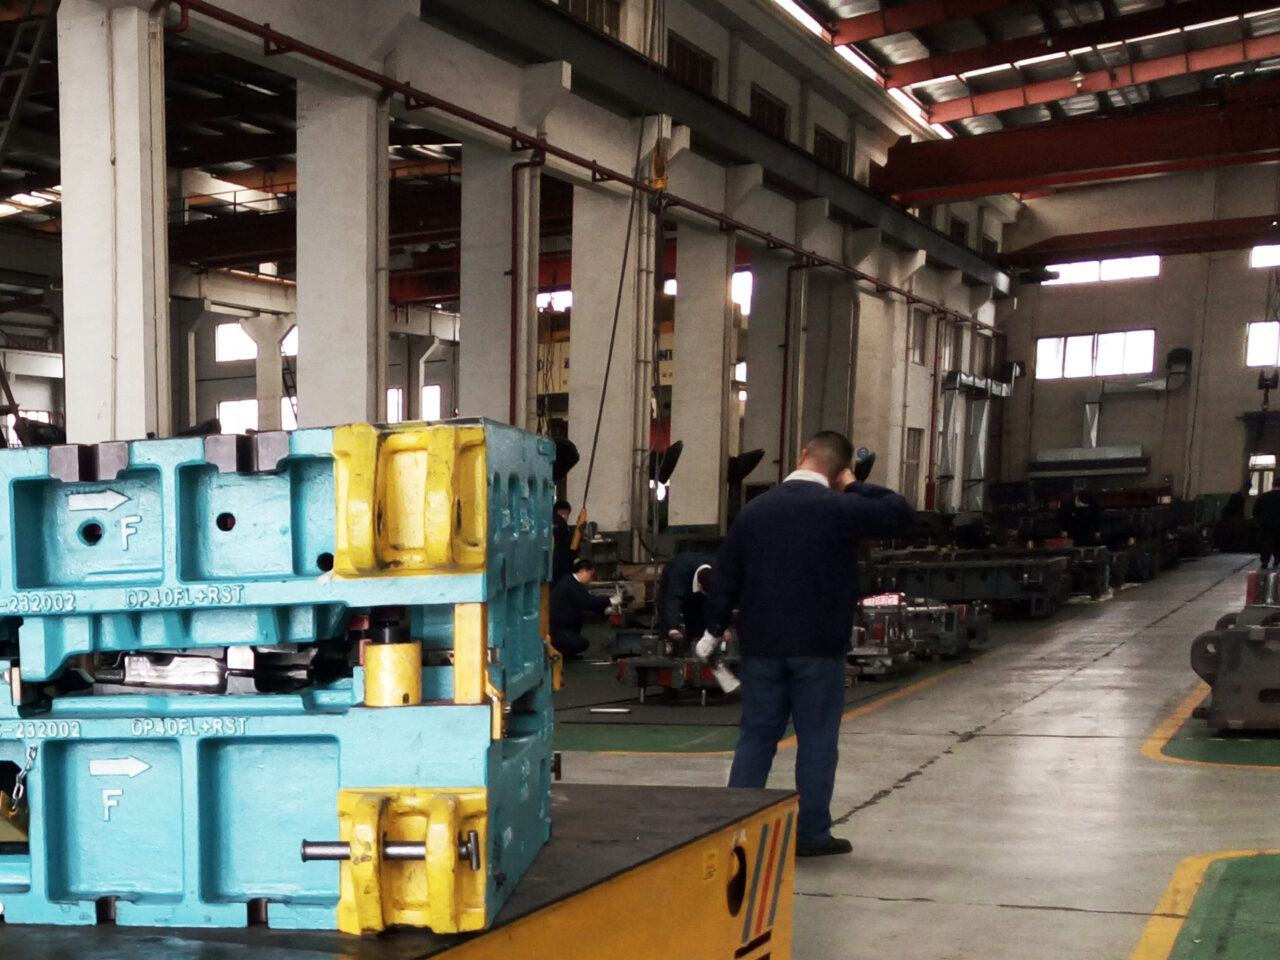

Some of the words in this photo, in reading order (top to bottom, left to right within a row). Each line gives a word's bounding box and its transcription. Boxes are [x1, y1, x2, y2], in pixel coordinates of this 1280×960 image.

[121, 515, 142, 551] F
[131, 717, 248, 736] OP40FL+RST
[102, 789, 124, 822] F
